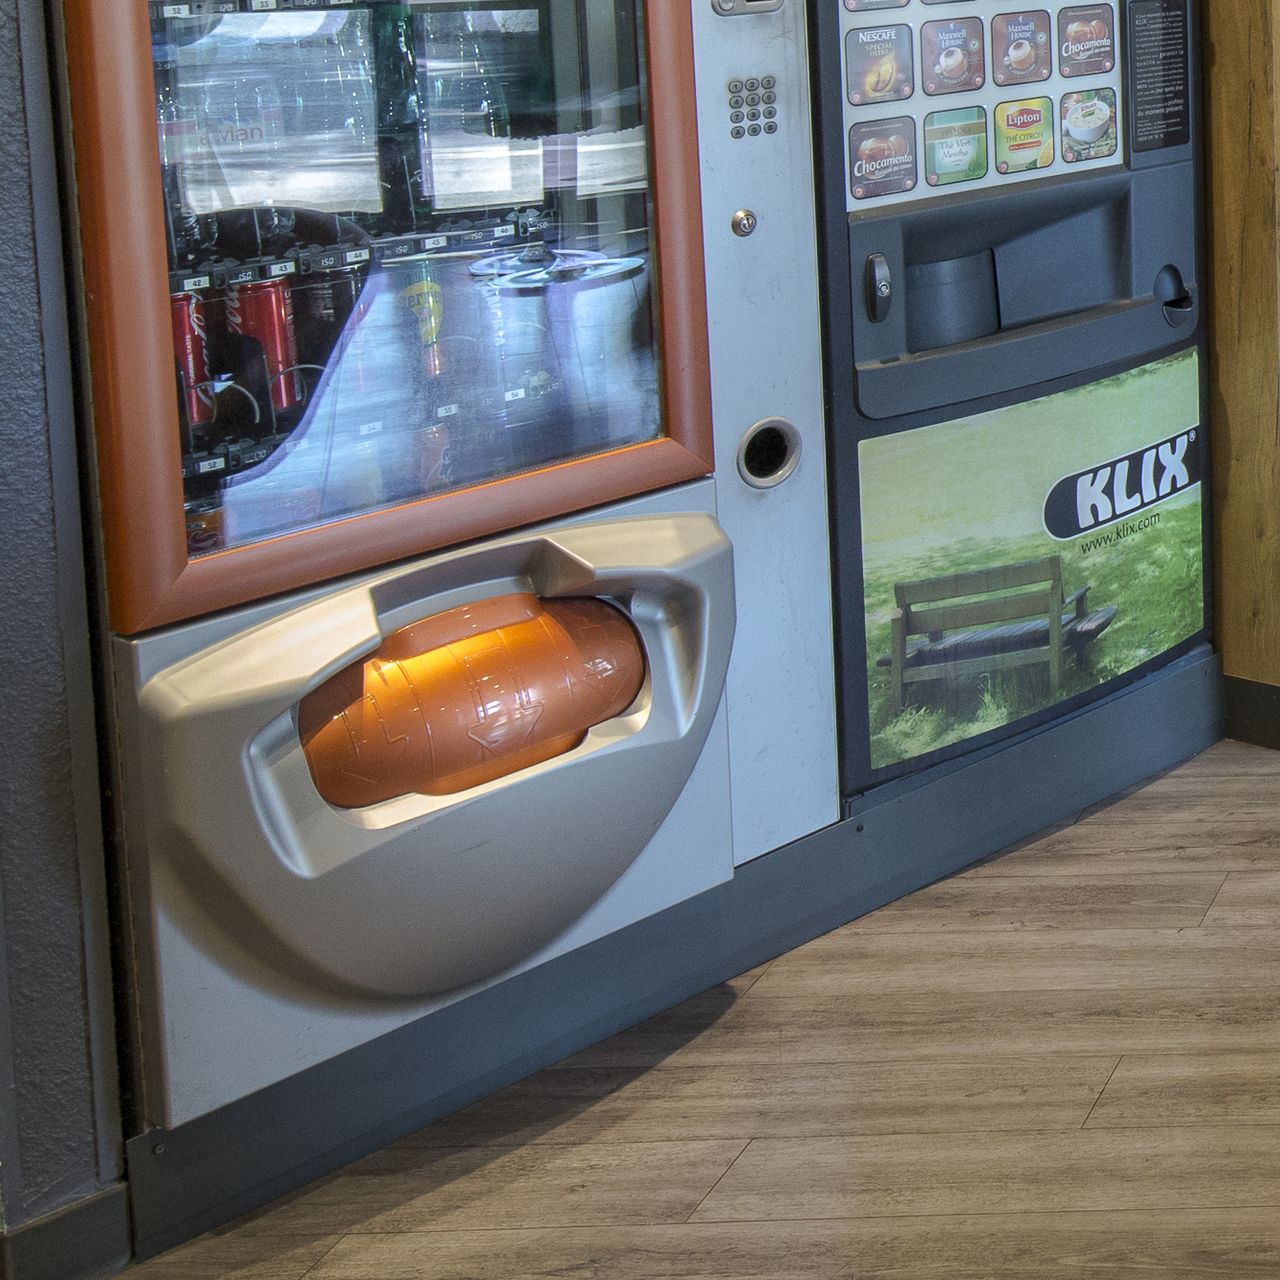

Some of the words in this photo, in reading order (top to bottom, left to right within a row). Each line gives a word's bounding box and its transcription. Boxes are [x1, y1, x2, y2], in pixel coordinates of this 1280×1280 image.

[858, 28, 897, 43] NESCAFÉ
[1007, 22, 1035, 32] Maxwell
[1061, 38, 1111, 57] Chocamento
[1008, 113, 1040, 126] Lipton
[854, 154, 913, 177] Chocamento
[1077, 434, 1189, 529] KLIX
[1081, 512, 1160, 554] www.klix.com
